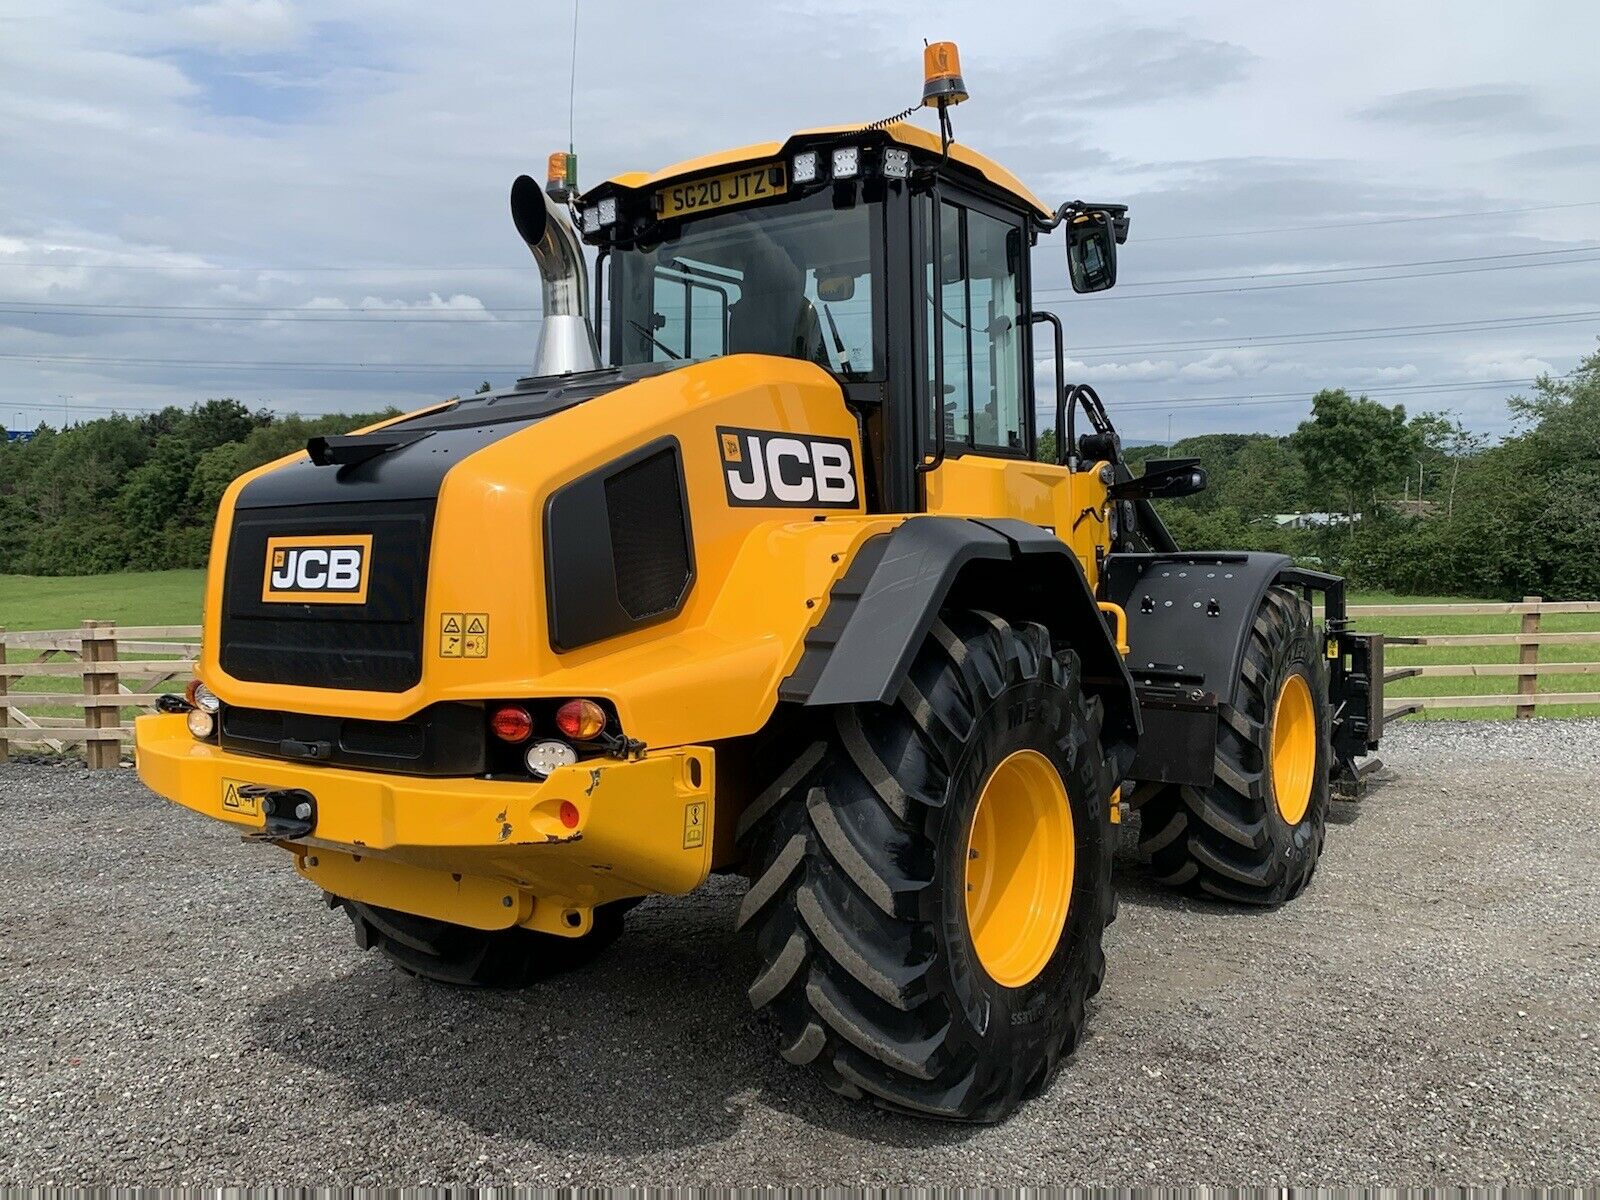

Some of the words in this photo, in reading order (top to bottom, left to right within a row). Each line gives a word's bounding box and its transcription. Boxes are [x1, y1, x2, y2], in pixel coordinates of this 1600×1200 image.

[673, 180, 721, 211] SG20
[728, 170, 766, 199] JTZ
[727, 435, 856, 502] JCB
[272, 549, 361, 589] JCB
